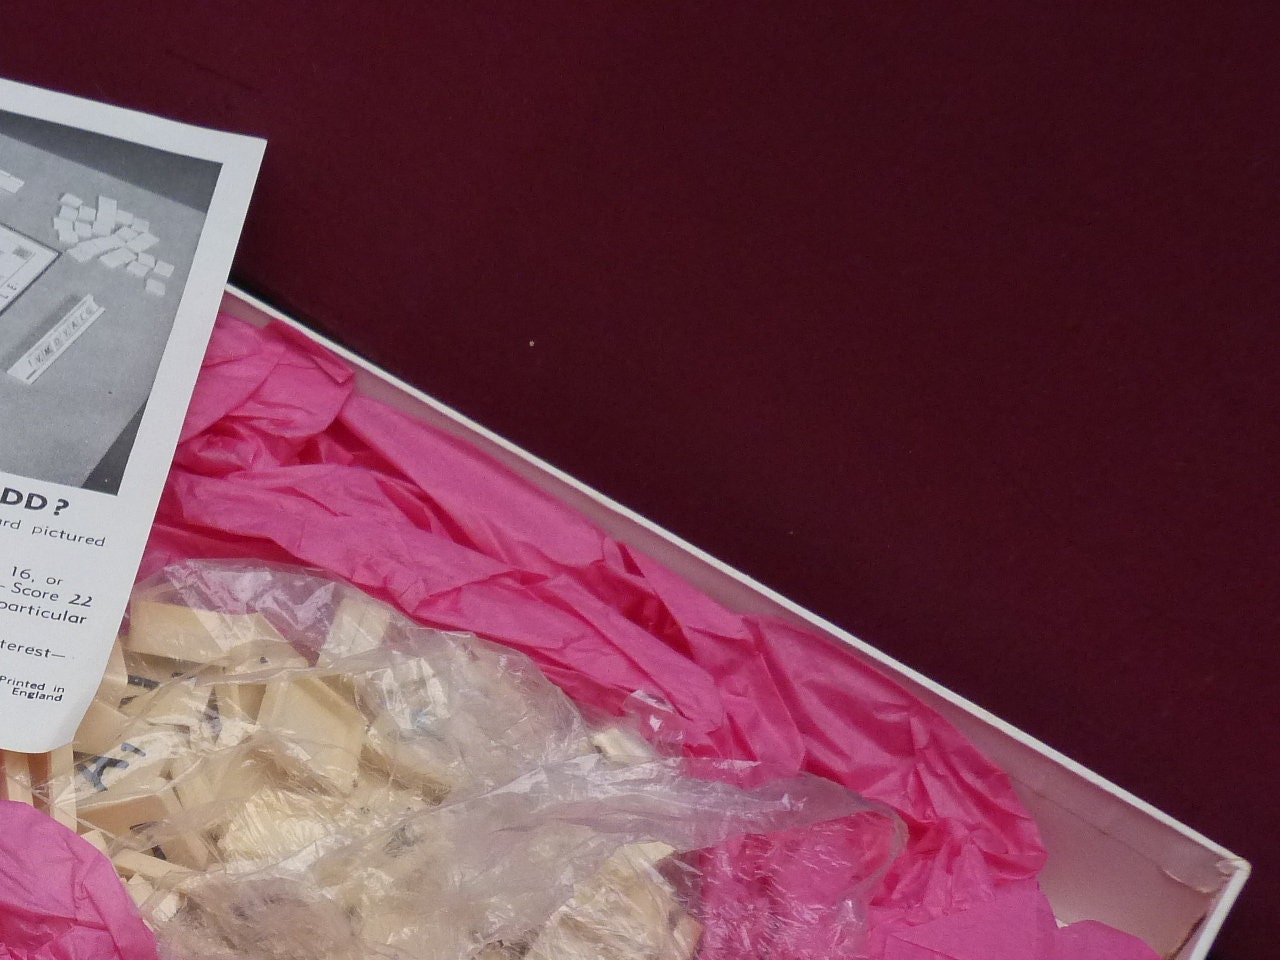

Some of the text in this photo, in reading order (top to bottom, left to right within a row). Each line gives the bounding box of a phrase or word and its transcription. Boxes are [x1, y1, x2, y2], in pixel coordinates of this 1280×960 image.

[32, 526, 105, 547] pictured
[0, 675, 65, 693] Printed in
[12, 685, 63, 701] England
